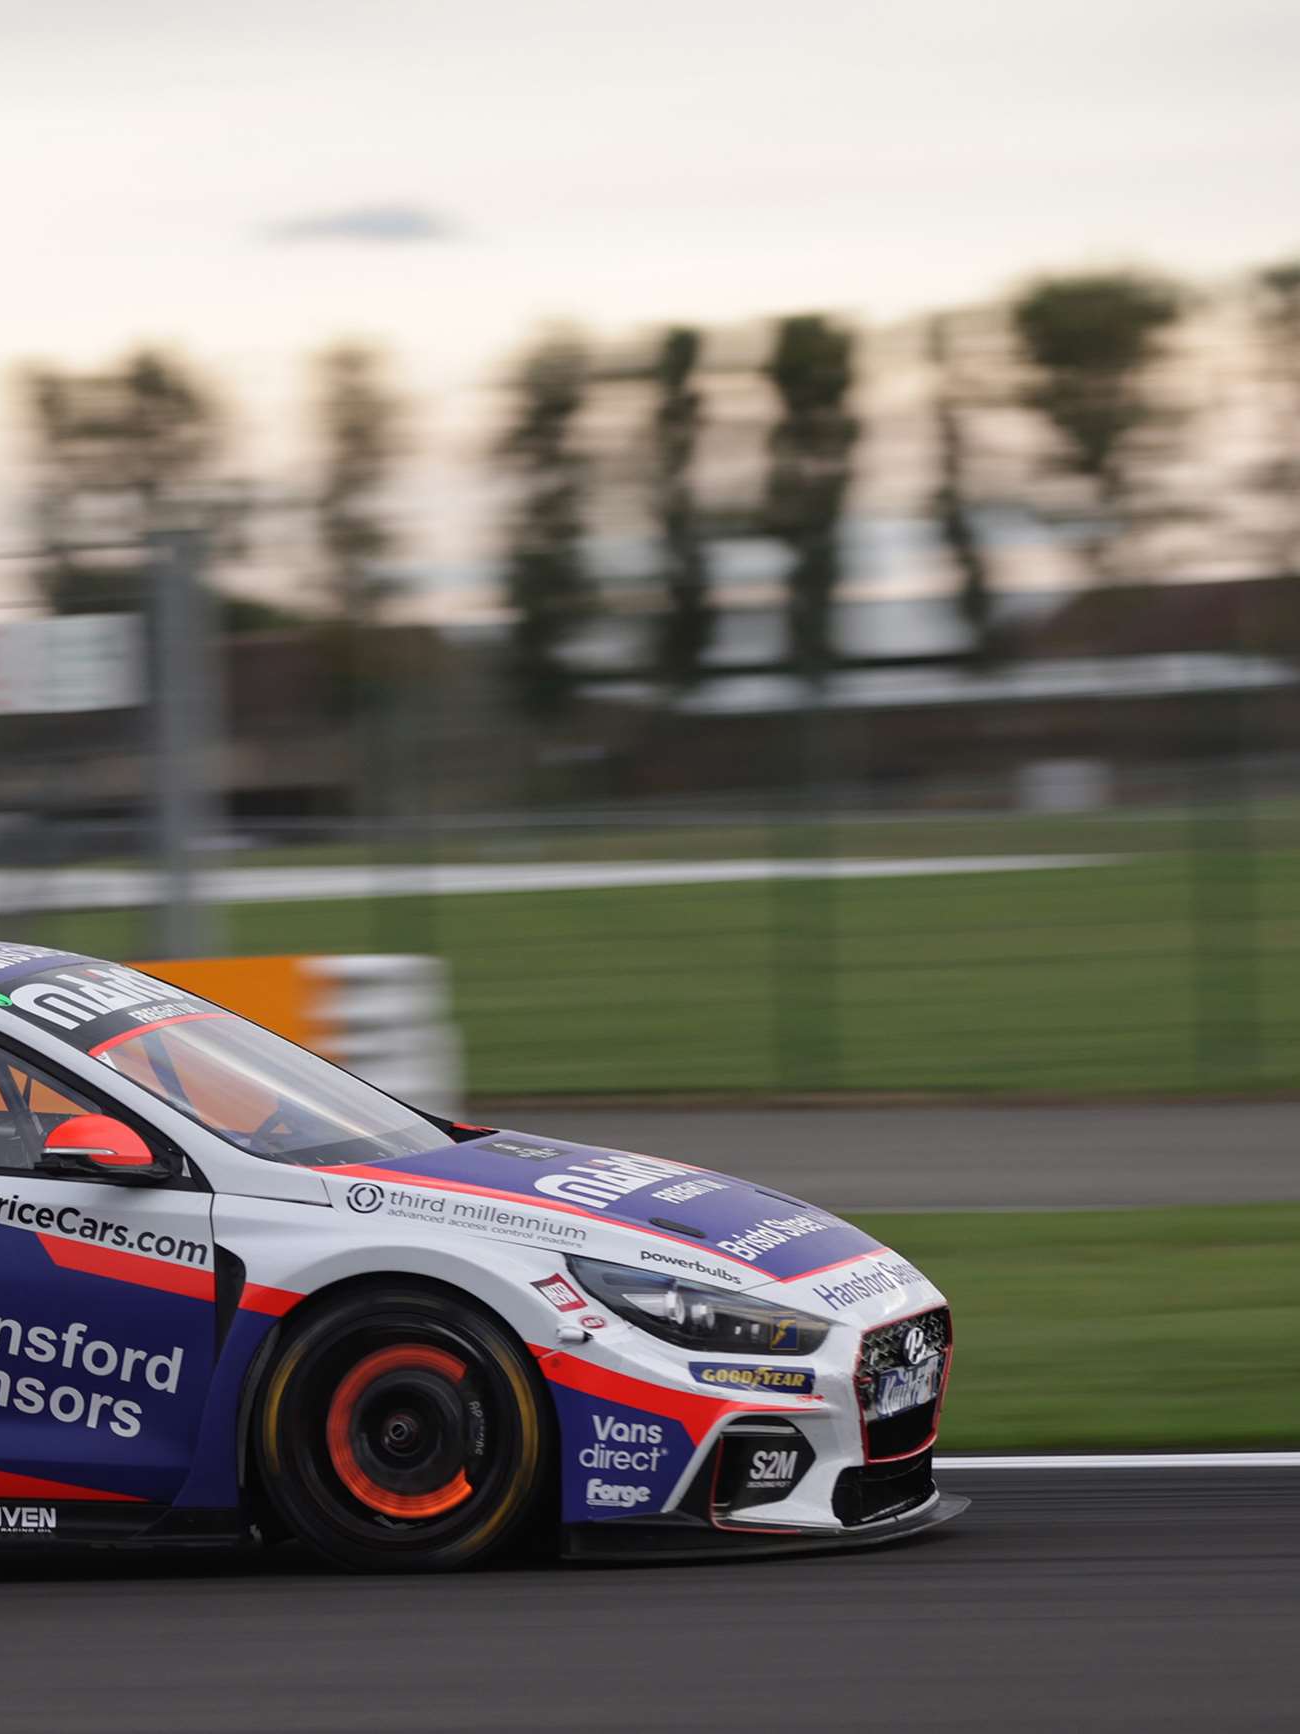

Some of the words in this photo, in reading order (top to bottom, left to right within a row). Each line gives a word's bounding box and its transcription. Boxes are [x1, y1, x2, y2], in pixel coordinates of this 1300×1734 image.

[387, 1208, 445, 1225] advanced
[448, 1219, 488, 1232] access
[491, 1225, 533, 1240] control
[536, 1233, 584, 1249] readers
[390, 1191, 445, 1213] third
[453, 1204, 587, 1241] millennium
[716, 1222, 792, 1262] Bristol
[640, 1249, 742, 1286] powerbulbs
[811, 1264, 898, 1311] Hansford
[701, 1366, 806, 1388] GOODYEAR
[591, 1414, 663, 1445] Vans
[749, 1450, 799, 1481] S2M
[586, 1478, 652, 1508] Forge
